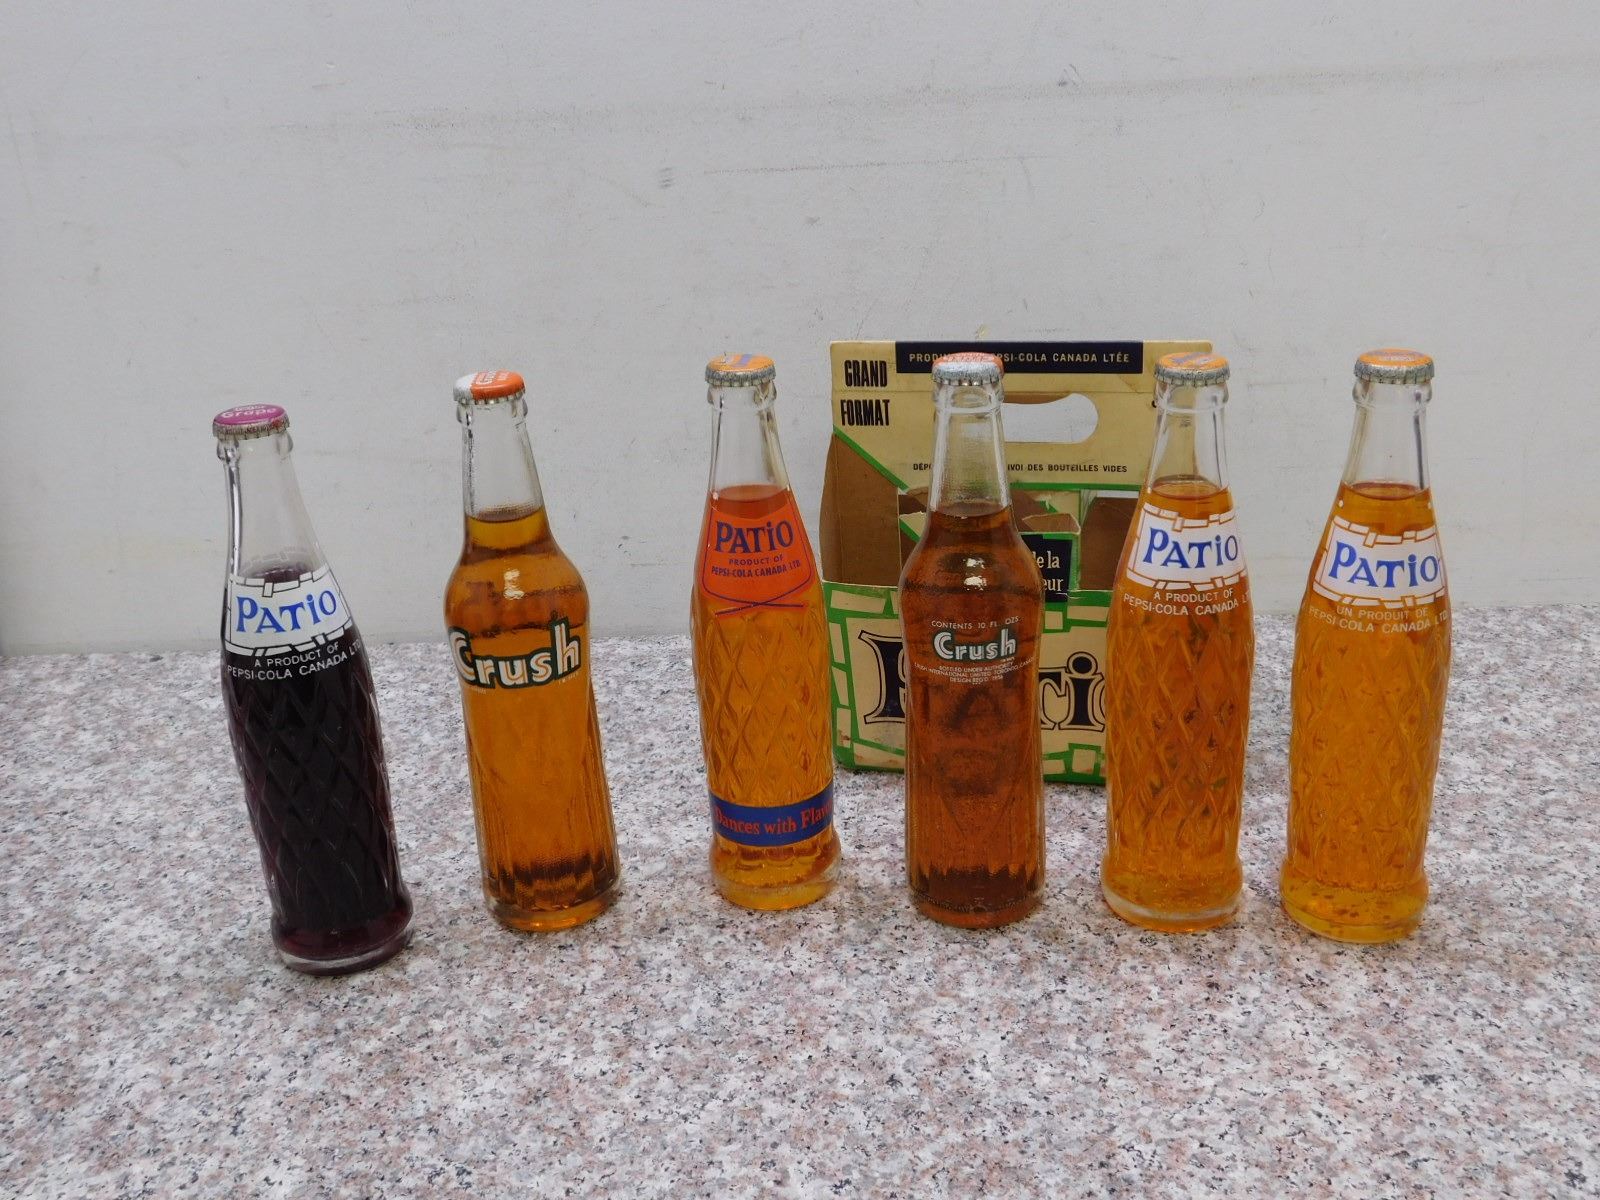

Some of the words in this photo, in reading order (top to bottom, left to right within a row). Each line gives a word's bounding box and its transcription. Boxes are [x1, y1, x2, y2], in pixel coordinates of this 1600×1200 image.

[1053, 352, 1098, 363] CANADA
[1103, 351, 1130, 363] LTÉE
[844, 359, 888, 388] GRAND
[220, 408, 277, 418] Grape
[840, 399, 890, 427] FORMAT
[1027, 464, 1044, 472] DES
[1047, 464, 1099, 472] BOUTEILLES
[1103, 465, 1128, 473] VIDES
[728, 557, 770, 566] PRODUCT
[773, 553, 783, 563] OF
[1046, 550, 1061, 569] la
[755, 565, 787, 577] CANADA
[1153, 591, 1161, 600] A
[1165, 591, 1219, 603] PRODUCT
[1223, 587, 1234, 599] OF
[1195, 598, 1239, 616] CANADA
[1336, 605, 1353, 618] UN
[1358, 609, 1410, 621] PRODUIT
[1415, 606, 1429, 618] DE
[931, 620, 973, 630] CONTENTS
[1381, 619, 1431, 633] CANADA
[448, 617, 581, 689] Crush
[932, 628, 1018, 661] Crush
[254, 660, 262, 668] A
[266, 649, 322, 667] PRODUCT
[326, 641, 340, 655] OF
[298, 650, 348, 676] CANADA
[714, 805, 760, 835] Dances
[764, 816, 798, 835] with
